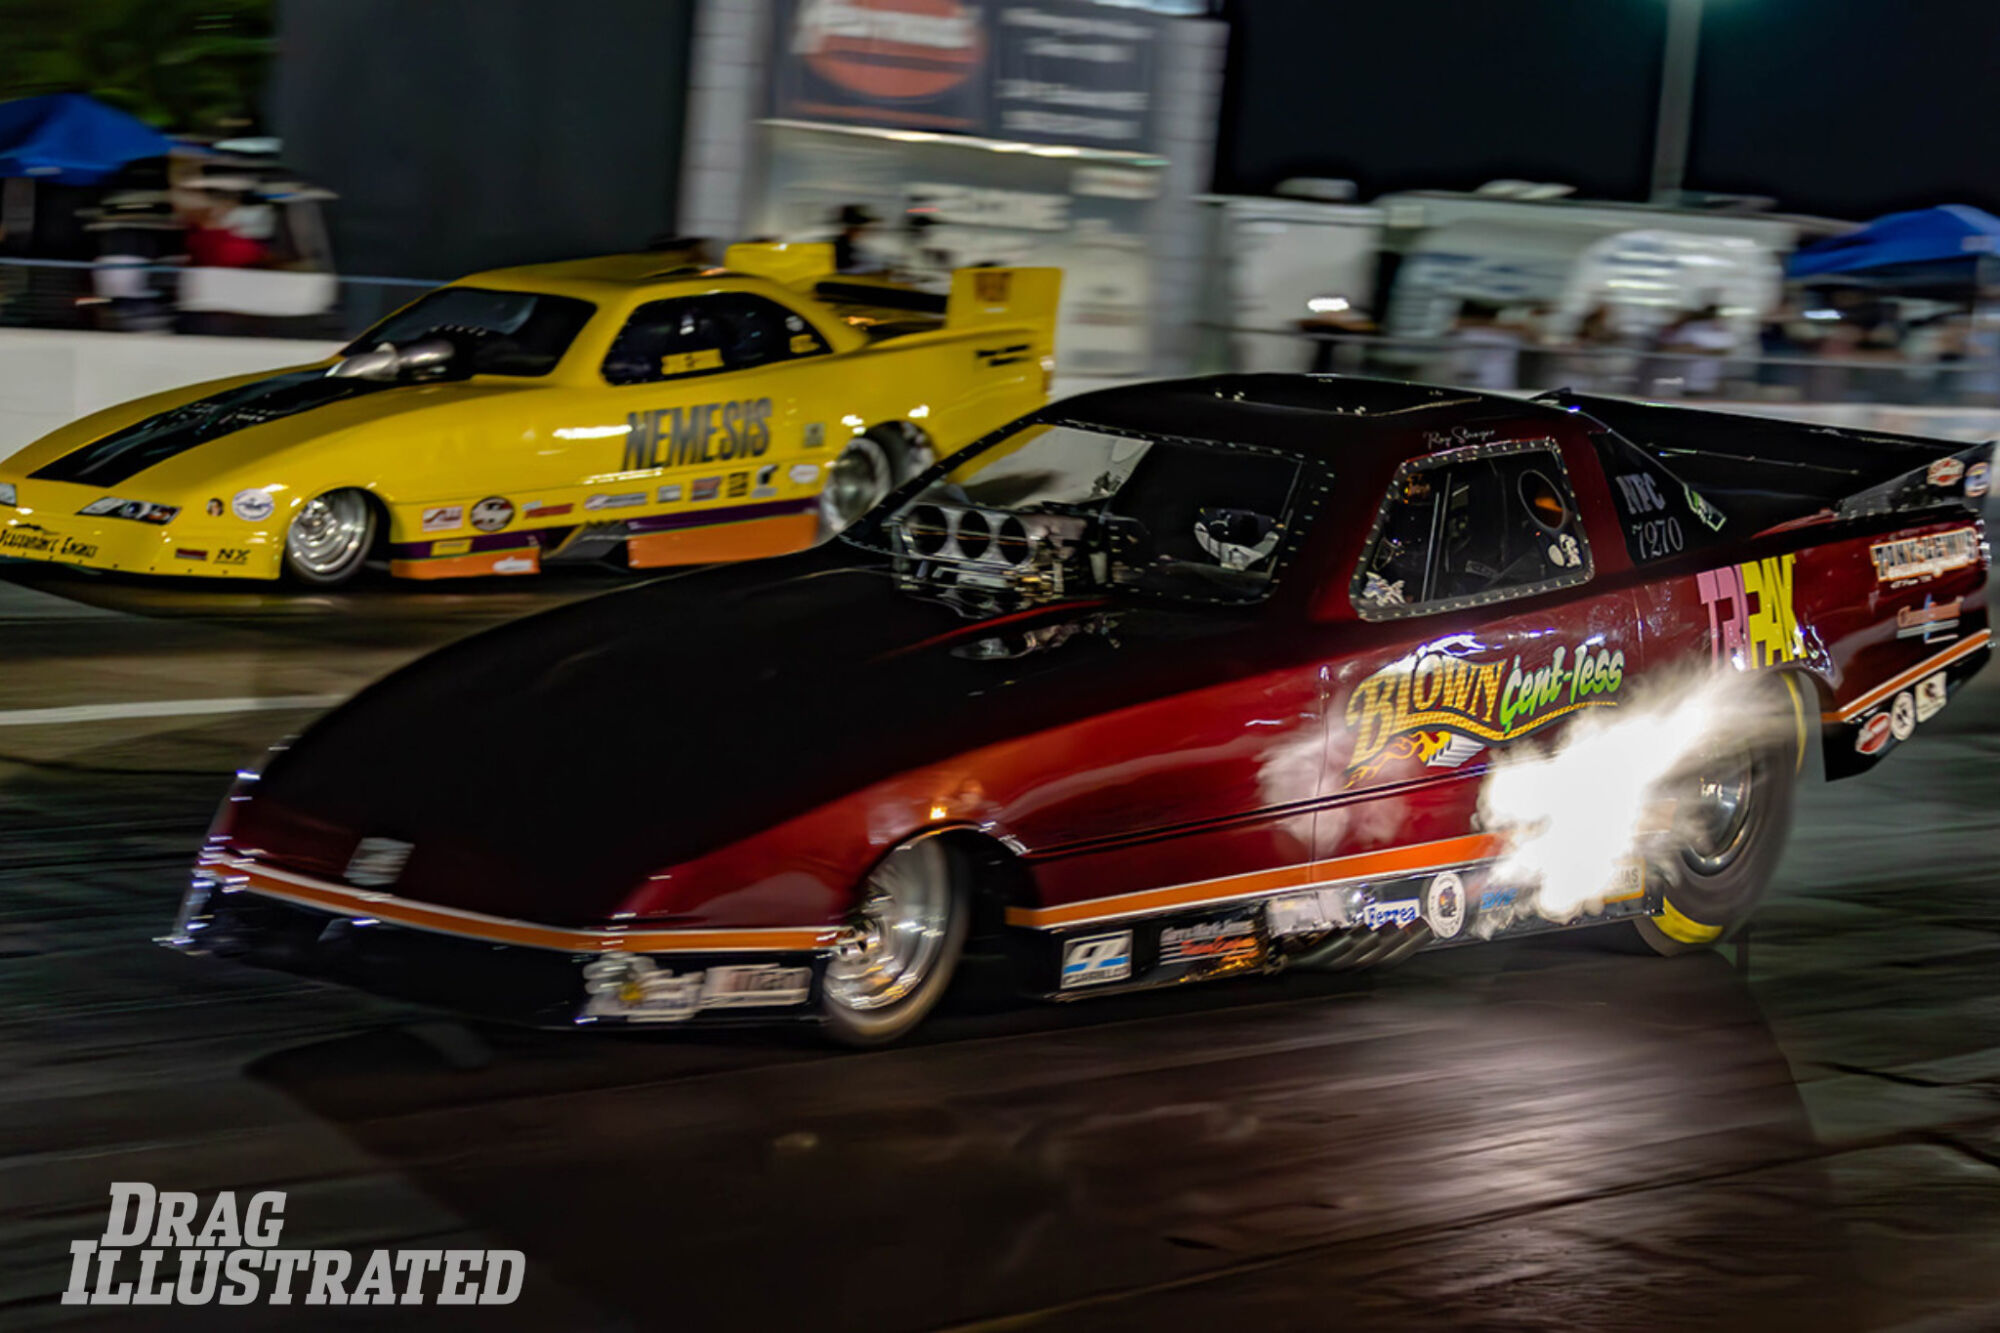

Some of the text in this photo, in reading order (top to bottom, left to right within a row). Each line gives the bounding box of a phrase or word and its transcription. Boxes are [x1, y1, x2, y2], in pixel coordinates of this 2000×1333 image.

[621, 397, 772, 472] NEMESIS
[1632, 516, 1684, 559] 7270
[1345, 653, 1508, 772] BLOWN
[1366, 905, 1416, 928] Ferrea
